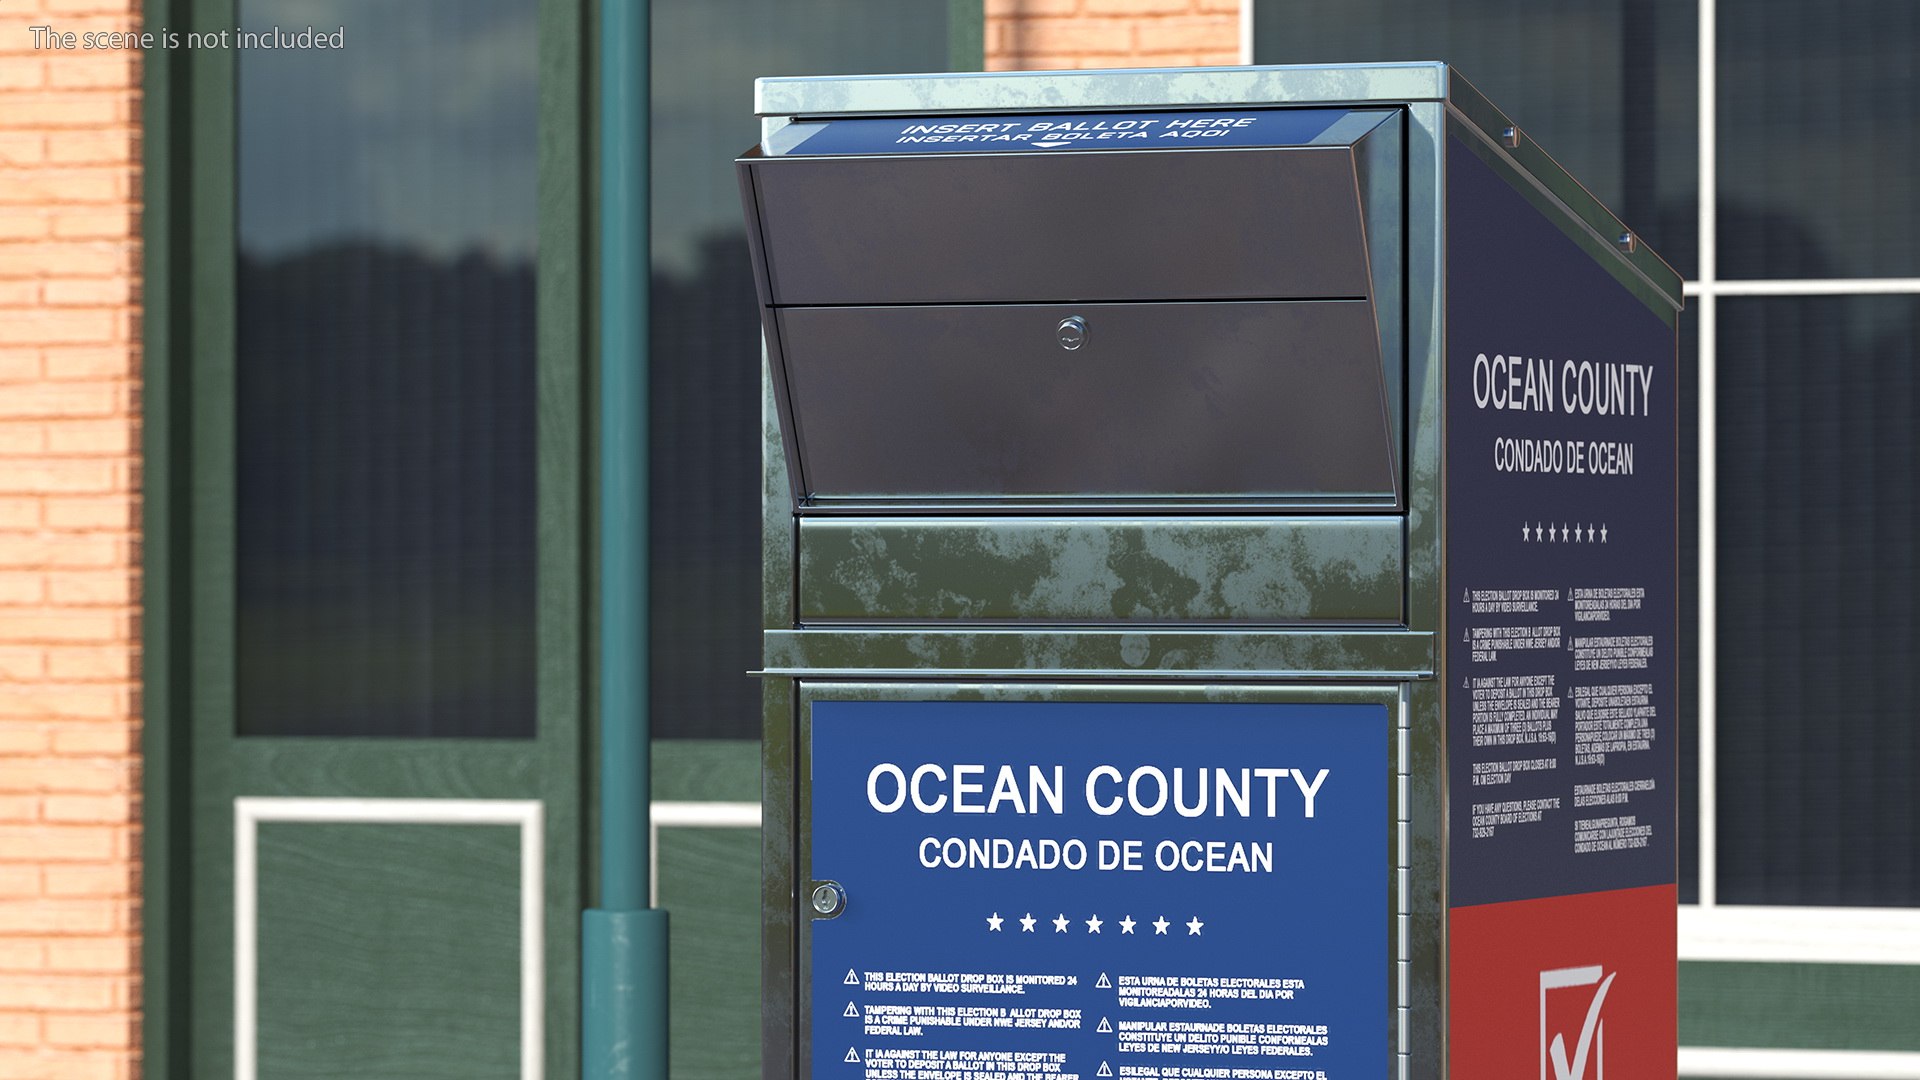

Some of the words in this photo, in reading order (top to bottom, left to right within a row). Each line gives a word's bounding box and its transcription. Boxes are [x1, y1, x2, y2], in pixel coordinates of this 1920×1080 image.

[900, 123, 1021, 135] INSERT
[1027, 120, 1159, 132] BALLOT
[1165, 117, 1257, 129] HERE
[895, 133, 1033, 144] INSERTAR
[1041, 131, 1148, 141] BOLETA
[1473, 353, 1554, 412] OCEAN
[1561, 359, 1653, 417] COUNTY
[1494, 436, 1563, 474] CONDADO
[1566, 440, 1585, 474] DE
[1588, 441, 1634, 475] OCEAN
[866, 762, 1063, 815] OCEAN
[1085, 764, 1330, 818] COUNTY
[919, 836, 1088, 870] CONDADO
[1098, 839, 1144, 871] DE
[1154, 839, 1273, 873] OCEAN
[865, 972, 883, 982] THIS
[885, 973, 926, 982] ELECTION
[927, 974, 958, 983] BALLOT
[960, 974, 984, 983] DROP
[986, 975, 1004, 984] BOX
[1005, 975, 1014, 984] IS
[1015, 975, 1065, 985] MONITORED
[1067, 976, 1077, 985] 24
[1119, 977, 1140, 986] ESTA
[1142, 978, 1165, 986] URNA
[1166, 978, 1178, 987] DE
[1180, 978, 1218, 987] BOLETAS
[1220, 979, 1280, 988] ELECTORALES
[1282, 980, 1304, 988] ESTA
[865, 982, 893, 992] HOURS
[895, 983, 900, 992] A
[902, 983, 918, 992] DAY
[920, 983, 932, 992] BY
[933, 984, 959, 993] VIDEO
[960, 984, 1024, 994] SURVEILLANCE.
[1119, 988, 1195, 998] MONITOREADALAS
[1197, 989, 1207, 998] 24
[1209, 990, 1239, 998] HORAS
[1240, 990, 1257, 999] DEL
[1275, 991, 1294, 999] POR
[1119, 998, 1211, 1008] VIGILANCIAPORVIDEO.
[865, 1006, 912, 1016] TAMPERING
[913, 1007, 935, 1016] WITH
[937, 1007, 955, 1016] THIS
[957, 1008, 998, 1017] ELECTION
[1000, 1008, 1006, 1017] B
[1009, 1009, 1036, 1018] ALLOT
[1037, 1009, 1061, 1018] DROP
[1063, 1010, 1081, 1018] BOX
[881, 1016, 908, 1025] CRIME
[909, 1017, 961, 1026] PUNISHABLE
[963, 1018, 992, 1026] UNDER
[993, 1018, 1013, 1027] NWE
[1014, 1019, 1046, 1028] JERSEY
[1048, 1019, 1080, 1028] AND/OR
[1119, 1022, 1167, 1032] MANIPULAR
[1168, 1023, 1225, 1033] ESTAURNADE
[1226, 1024, 1265, 1033] BOLETAS
[1266, 1025, 1327, 1034] ELECTORALES
[865, 1026, 901, 1035] FEDERAL
[903, 1027, 923, 1036] LAW.
[1119, 1033, 1172, 1042] CONSTITUYE
[1174, 1034, 1186, 1043] UN
[1188, 1034, 1218, 1043] DELITO
[1220, 1034, 1256, 1044] PUNIBLE
[1258, 1035, 1328, 1045] CONFORMEALAS
[1119, 1043, 1146, 1053] LEYES
[1147, 1044, 1159, 1053] DE
[1161, 1044, 1180, 1053] NEW
[1182, 1045, 1229, 1054] JERSEYY/O
[1231, 1046, 1259, 1055] LEYES
[1260, 1046, 1313, 1056] FEDERALES.
[865, 1050, 873, 1058] IT
[884, 1050, 920, 1059] AGAINST
[922, 1051, 938, 1060] THE
[939, 1051, 957, 1060] LAW
[959, 1052, 976, 1061] FOR
[978, 1052, 1012, 1062] ANYONE
[1014, 1053, 1047, 1062] EXCEPT
[1049, 1053, 1065, 1063] THE
[865, 1060, 893, 1068] VOTER
[895, 1060, 906, 1069] TO
[908, 1061, 943, 1070] DEPOSIT
[945, 1061, 951, 1070] A
[952, 1062, 984, 1070] BALLOT
[985, 1062, 995, 1070] IN
[997, 1062, 1015, 1071] THIS
[1017, 1063, 1041, 1071] DROP
[1042, 1063, 1060, 1072] BOX
[1120, 1067, 1160, 1077] ESILEGAL
[1161, 1068, 1180, 1077] QUE
[1181, 1068, 1230, 1078] CUALQUIER
[1232, 1069, 1272, 1079] PERSONA
[1274, 1070, 1314, 1080] EXCEPTO
[1315, 1070, 1327, 1080] EL
